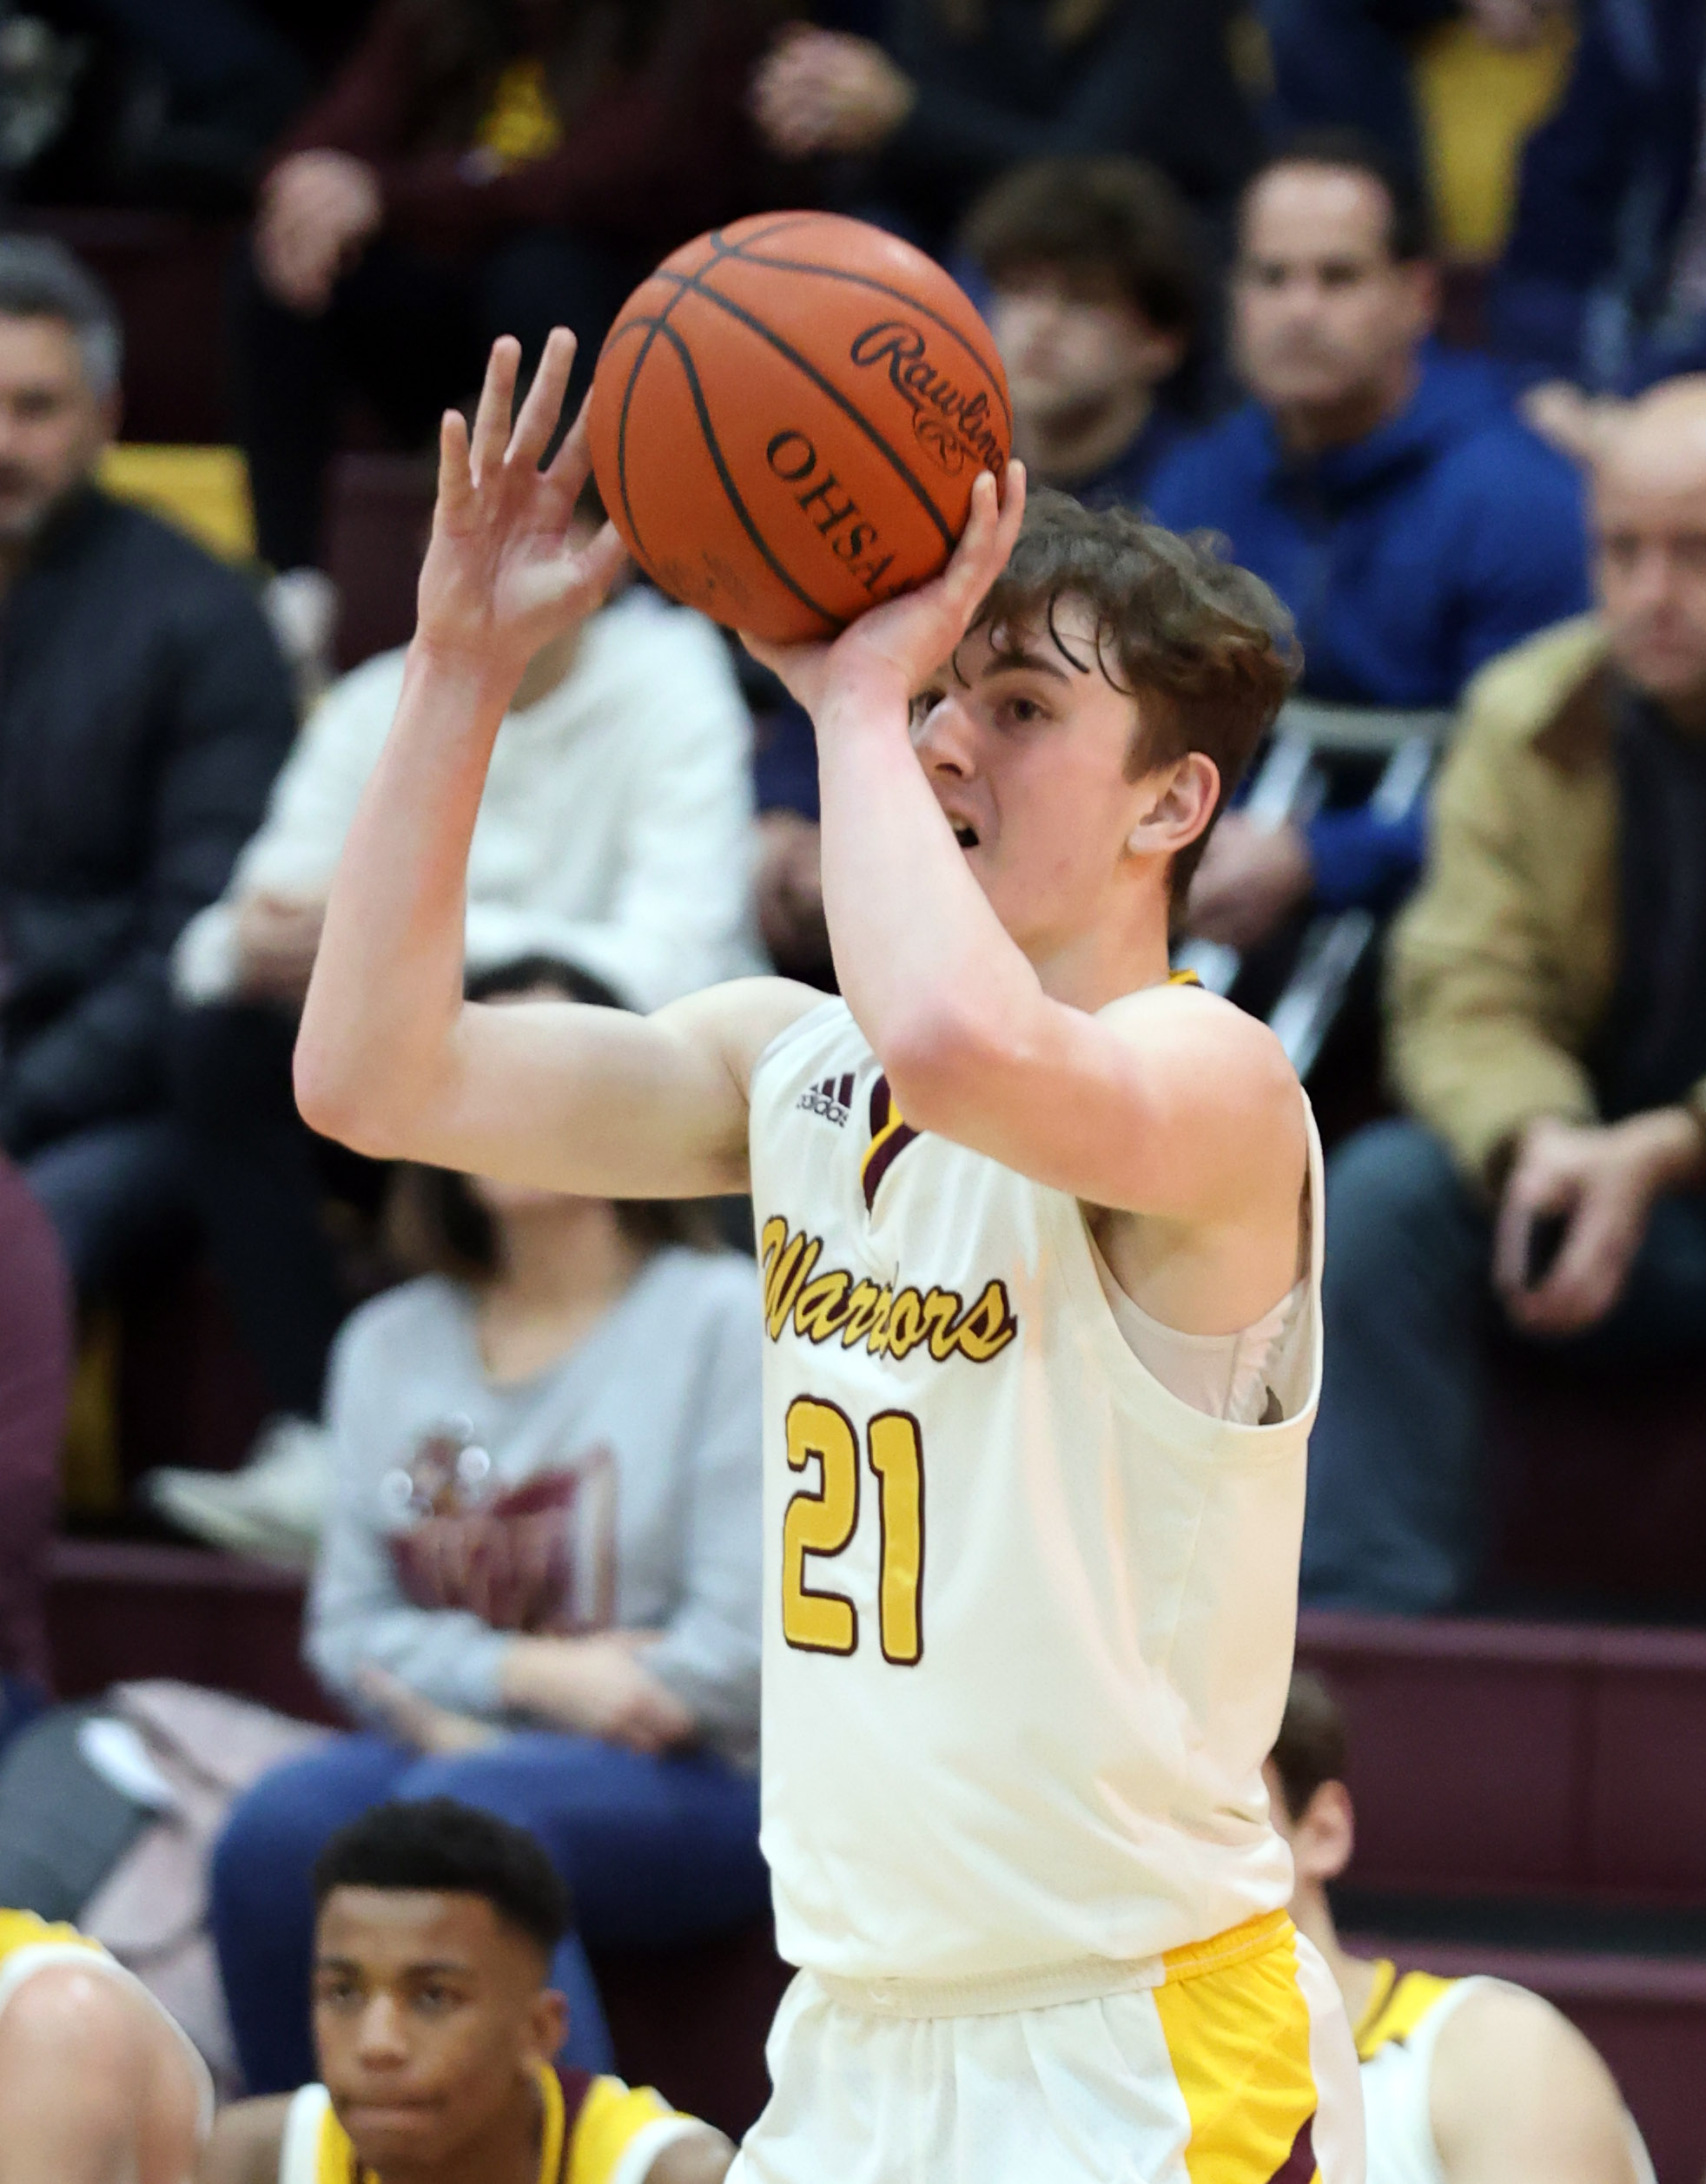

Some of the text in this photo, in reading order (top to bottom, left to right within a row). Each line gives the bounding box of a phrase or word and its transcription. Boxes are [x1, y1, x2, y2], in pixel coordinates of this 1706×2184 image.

[766, 429, 914, 597] OHSA
[797, 1092, 849, 1128] didas
[782, 1392, 925, 1666] 21
